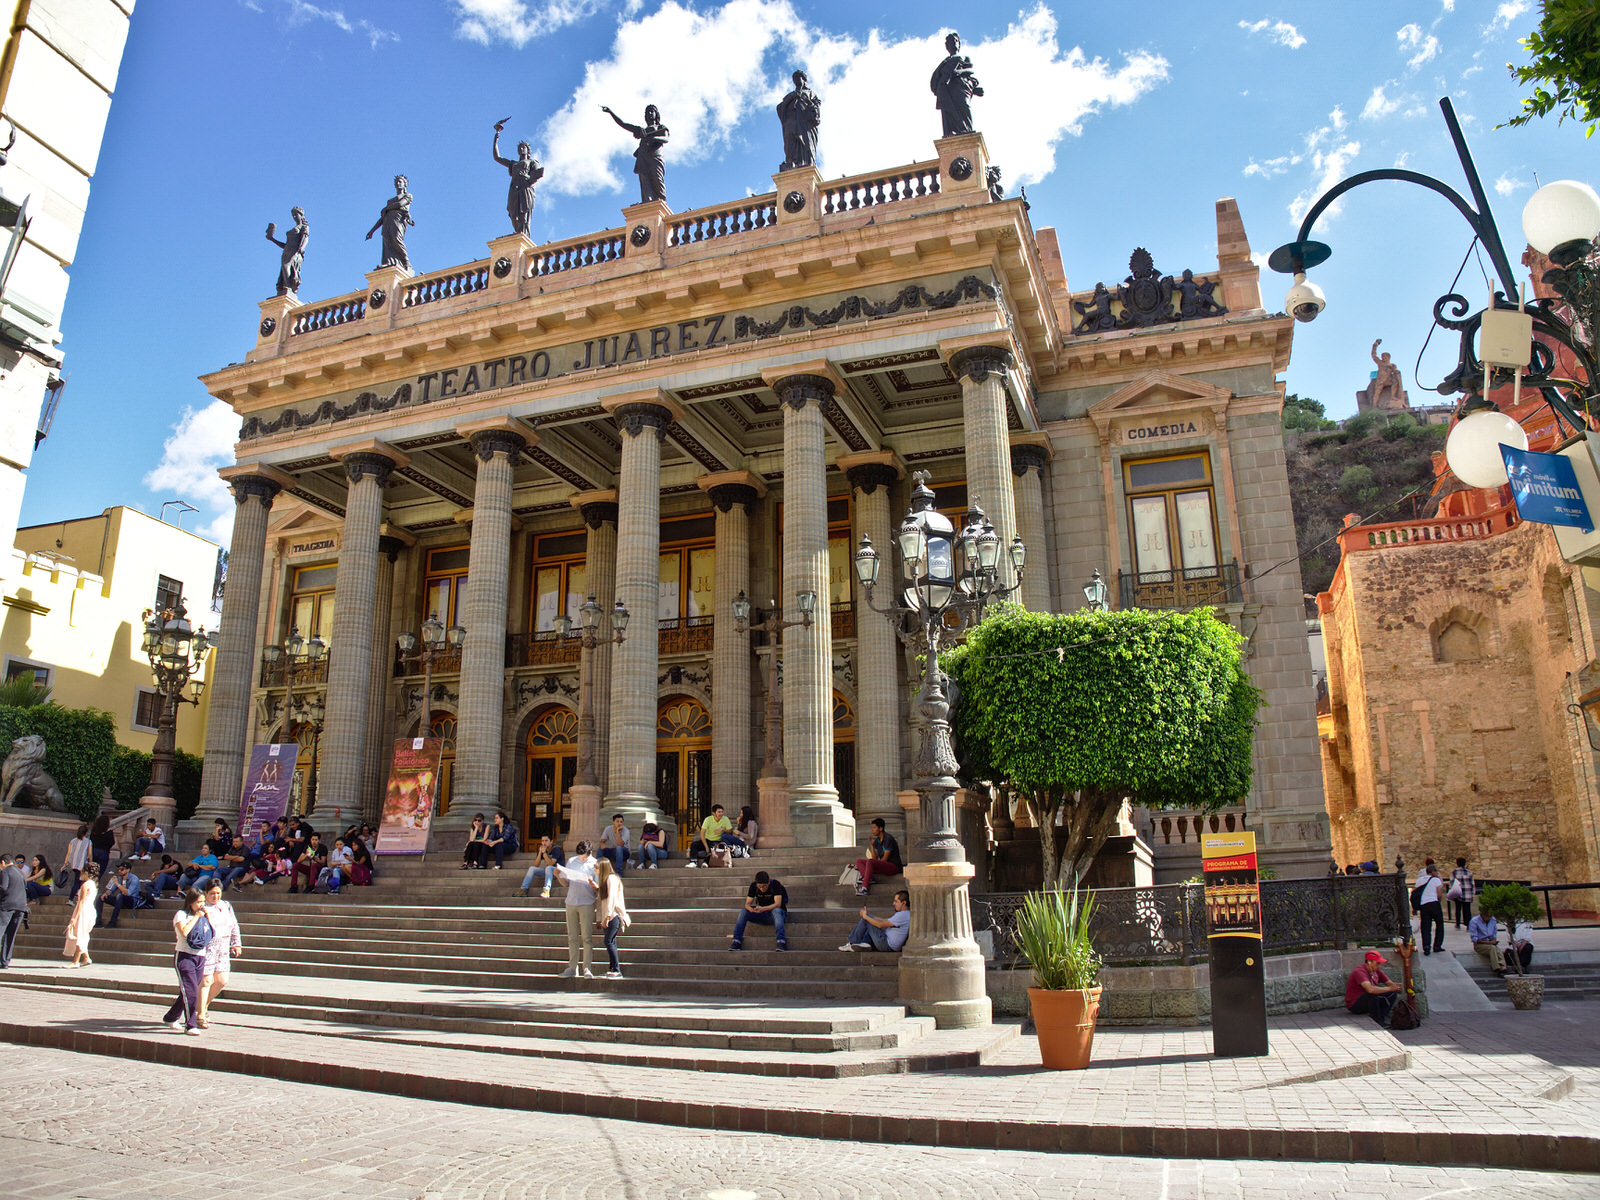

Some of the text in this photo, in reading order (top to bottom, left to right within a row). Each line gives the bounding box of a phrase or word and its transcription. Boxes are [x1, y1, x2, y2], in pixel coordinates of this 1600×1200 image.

[418, 315, 726, 402] TEATRO JUAREZ
[1128, 422, 1197, 439] COMEDIA
[1510, 475, 1580, 500] infinitum
[294, 540, 334, 552] TRAGEDIA
